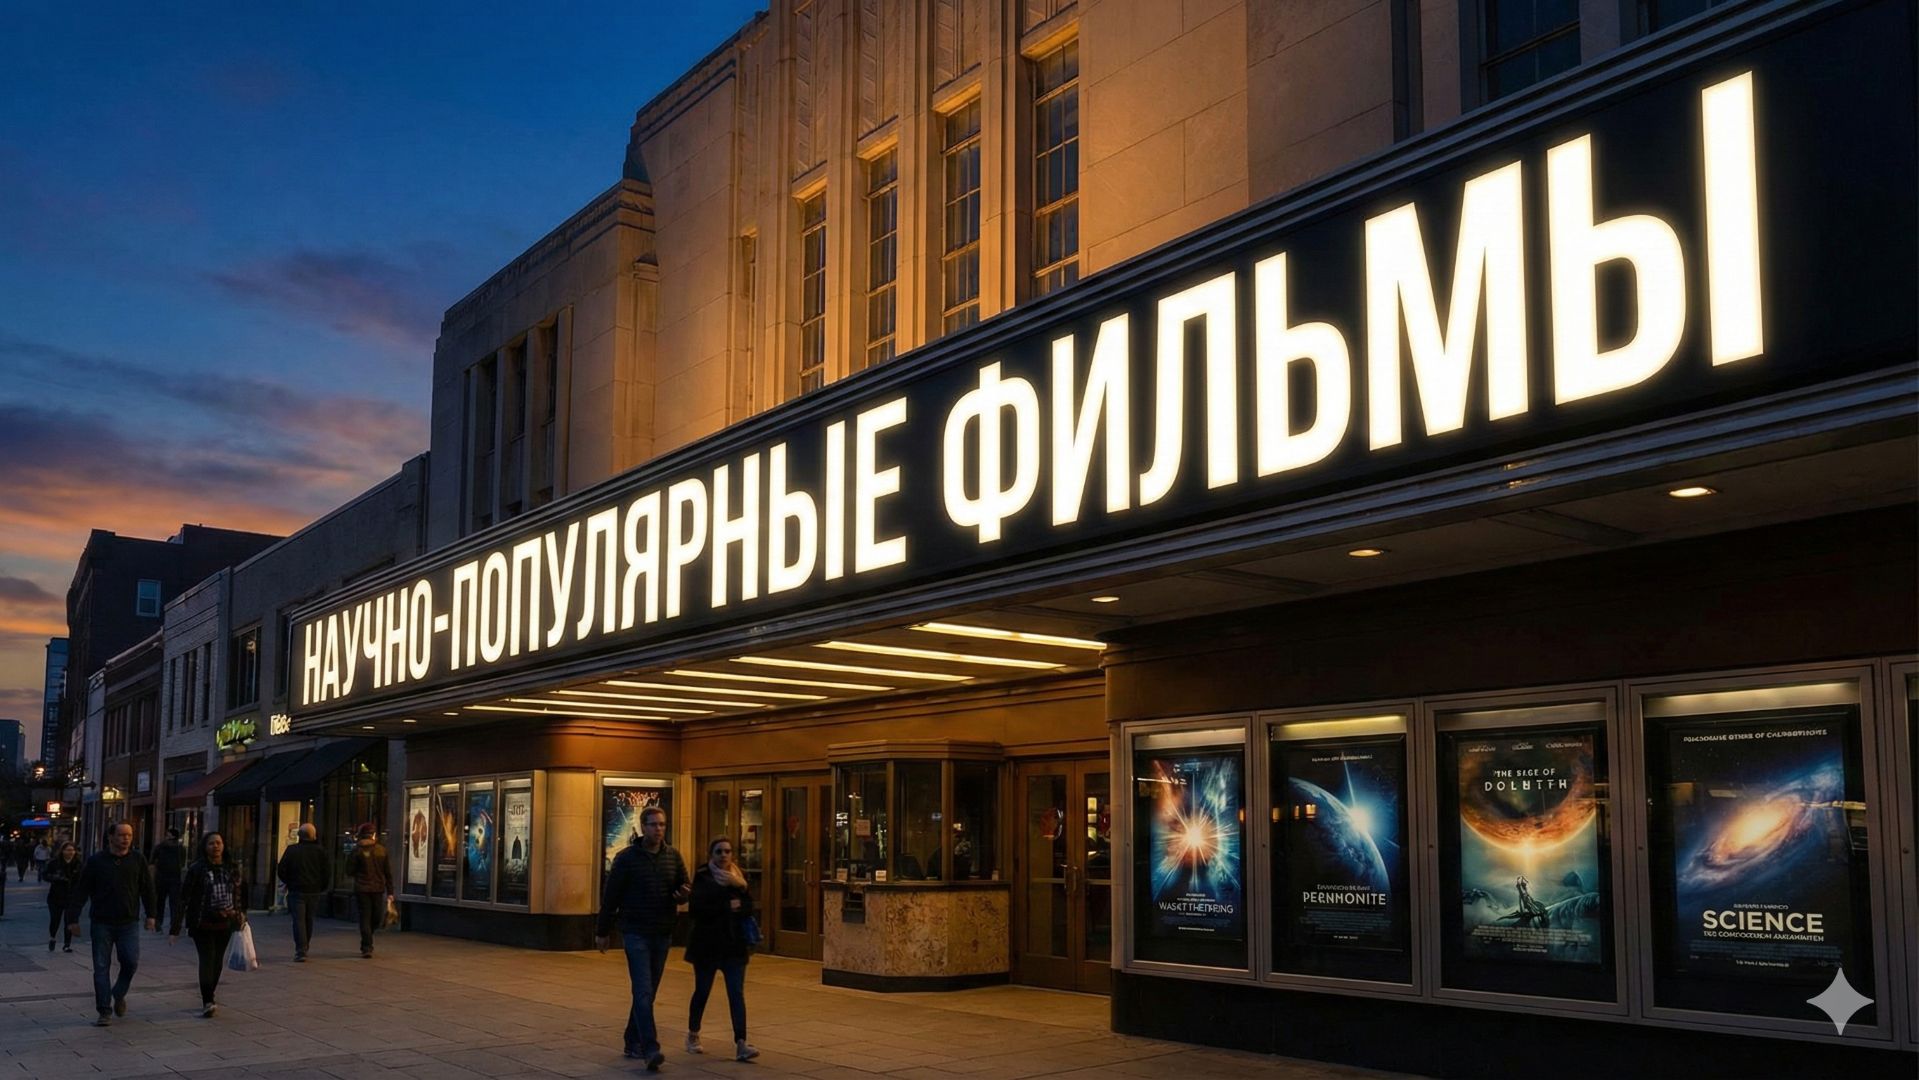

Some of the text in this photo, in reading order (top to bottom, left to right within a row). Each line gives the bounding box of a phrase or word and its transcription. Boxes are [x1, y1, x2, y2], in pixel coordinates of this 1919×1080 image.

[302, 70, 1765, 706] НАУЧНО-ПОПУЛЯРНЫЕ ФИЛЬМЫ
[1542, 768, 1556, 776] OF
[1703, 909, 1824, 933] SCIENCE
